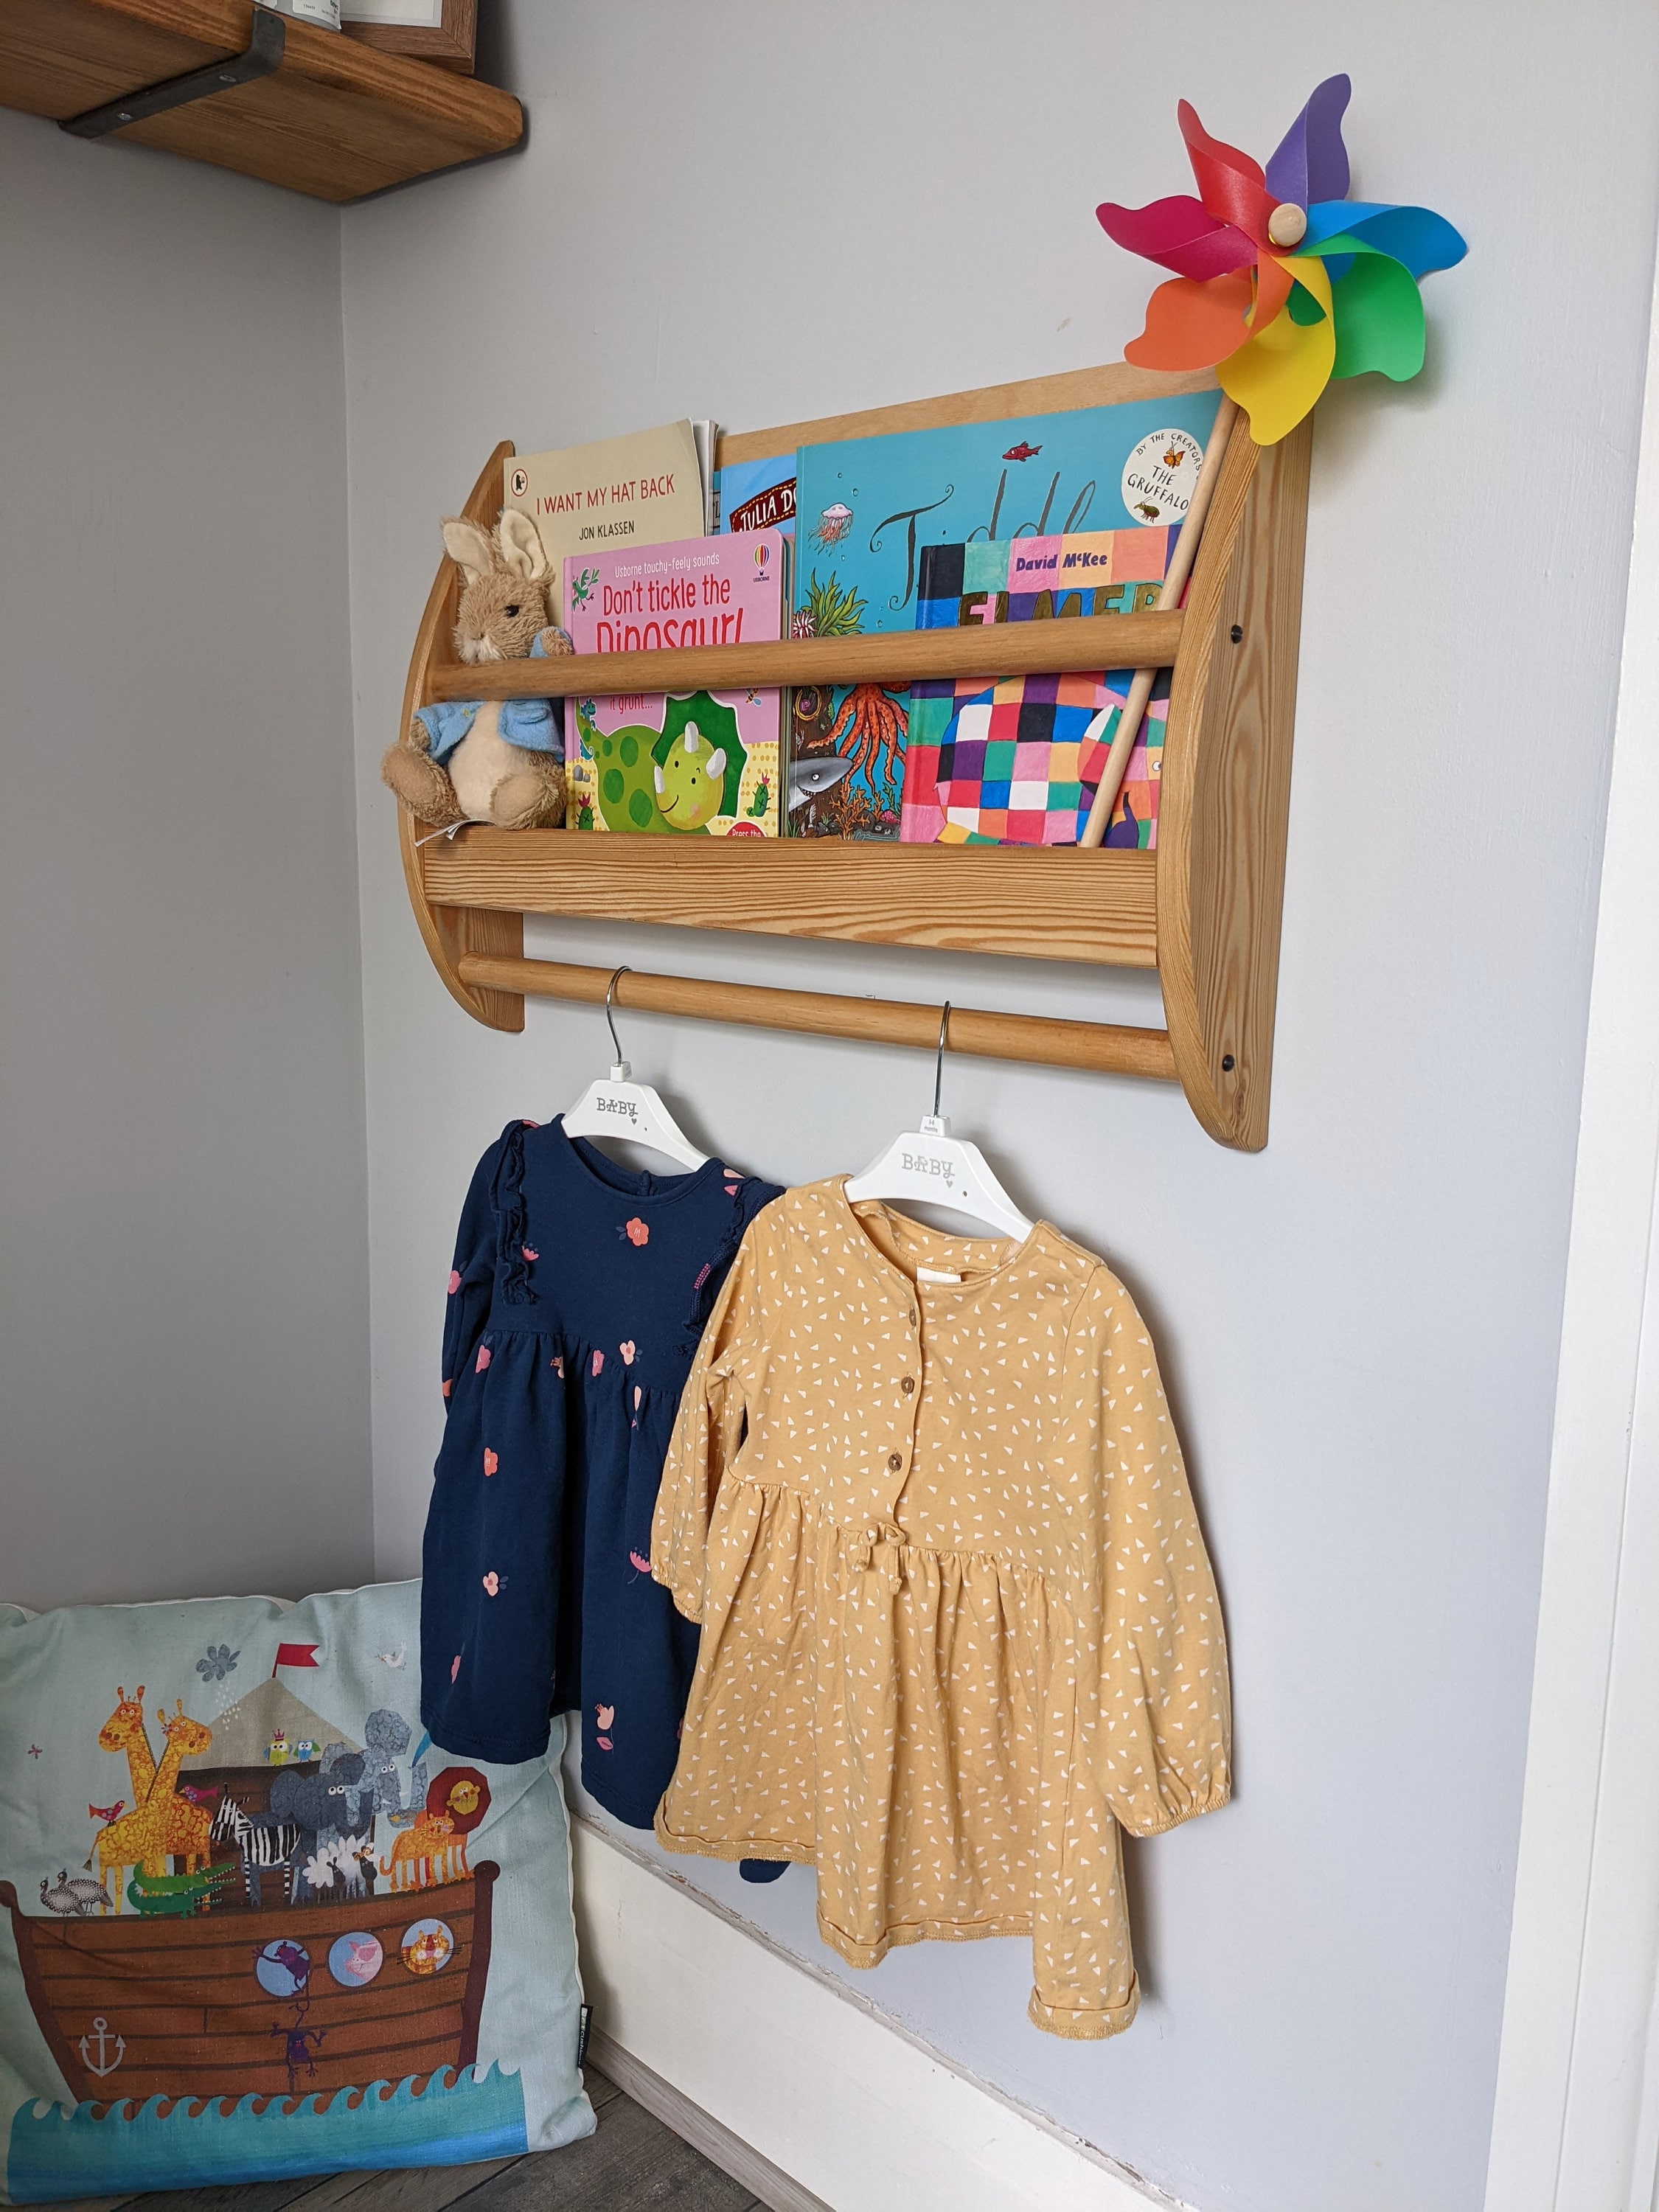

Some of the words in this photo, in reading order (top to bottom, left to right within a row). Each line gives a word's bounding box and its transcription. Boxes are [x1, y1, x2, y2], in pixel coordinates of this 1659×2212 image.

[1136, 442, 1147, 456] BY
[1150, 433, 1165, 443] THE
[1171, 433, 1203, 471] CREATORS
[1153, 465, 1177, 486] THE
[536, 498, 540, 515] I
[544, 492, 582, 515] WANT
[587, 487, 607, 507] MY
[611, 481, 637, 504] HAT
[641, 473, 675, 499] BACK
[1127, 473, 1189, 510] GRUFFALO
[740, 495, 777, 532] JULIA
[579, 526, 595, 540] JON
[597, 521, 635, 538] KLASSEN
[615, 560, 642, 578] Usborne
[644, 555, 691, 575] touchy-feely
[692, 552, 720, 568] sounds
[1015, 554, 1057, 572] David
[1062, 552, 1107, 568] McKee
[602, 580, 643, 616] Don't
[647, 577, 696, 613] tickle
[702, 573, 731, 606] the
[610, 696, 616, 710] it
[619, 693, 653, 714] grunt...
[597, 1097, 639, 1117] BABY
[902, 1152, 956, 1178] BABY
